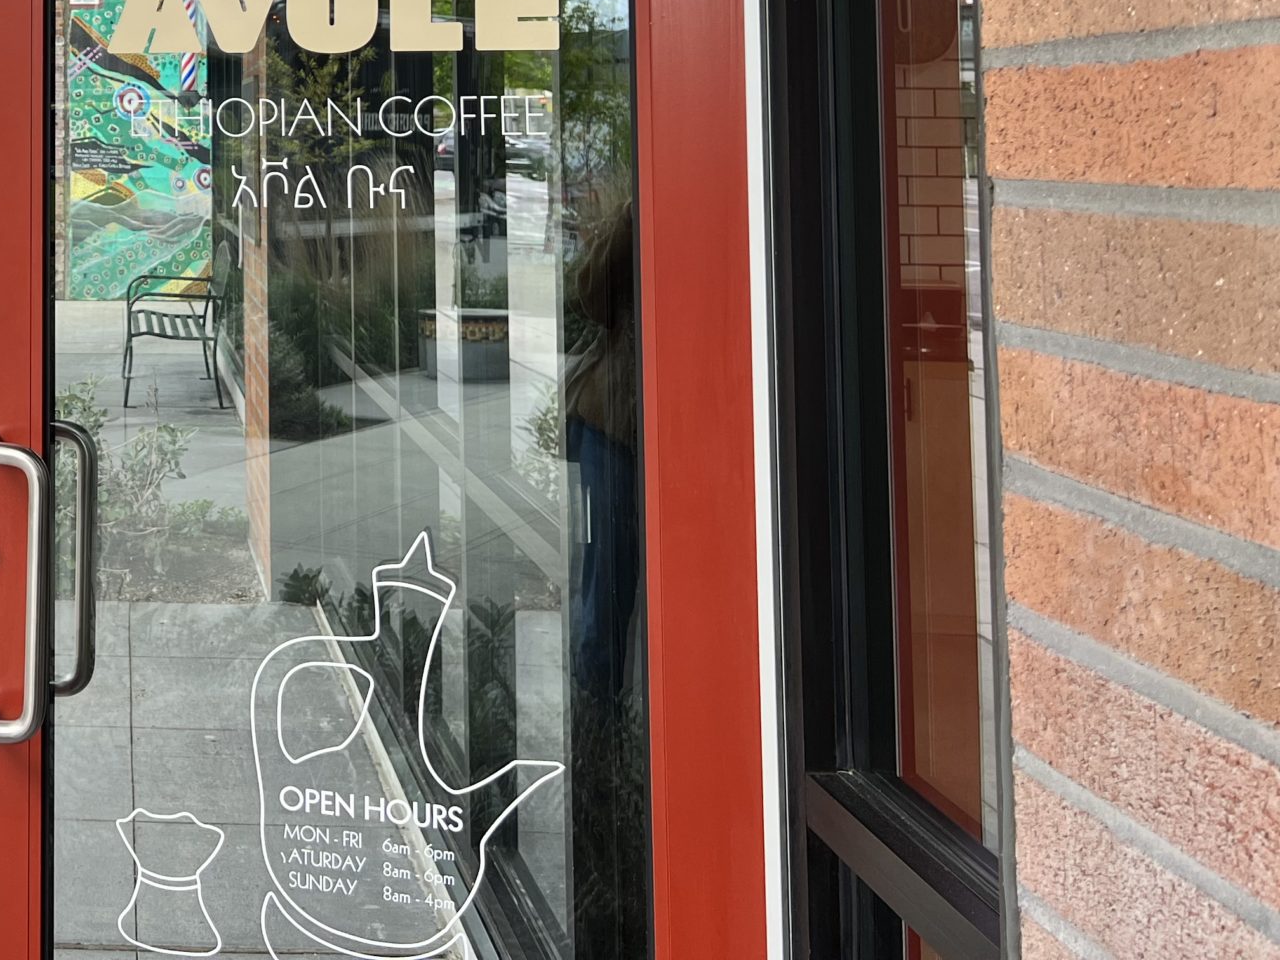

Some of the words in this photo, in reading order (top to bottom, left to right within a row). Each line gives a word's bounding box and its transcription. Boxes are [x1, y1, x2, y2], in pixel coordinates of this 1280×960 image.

[131, 96, 361, 137] ETHIOPIAN
[379, 95, 547, 137] COFFEE
[280, 786, 354, 819] OPEN
[364, 795, 464, 832] HOURS
[284, 824, 329, 844] MON
[343, 831, 362, 848] FRI
[382, 838, 410, 856] 6am
[424, 844, 455, 863] 6pm
[280, 848, 366, 872] ATURDAY
[383, 862, 410, 880] 8am
[424, 868, 455, 887] 6pm
[289, 871, 357, 895] SUNDAY
[383, 886, 410, 904] 8am
[425, 893, 455, 911] 4pm
